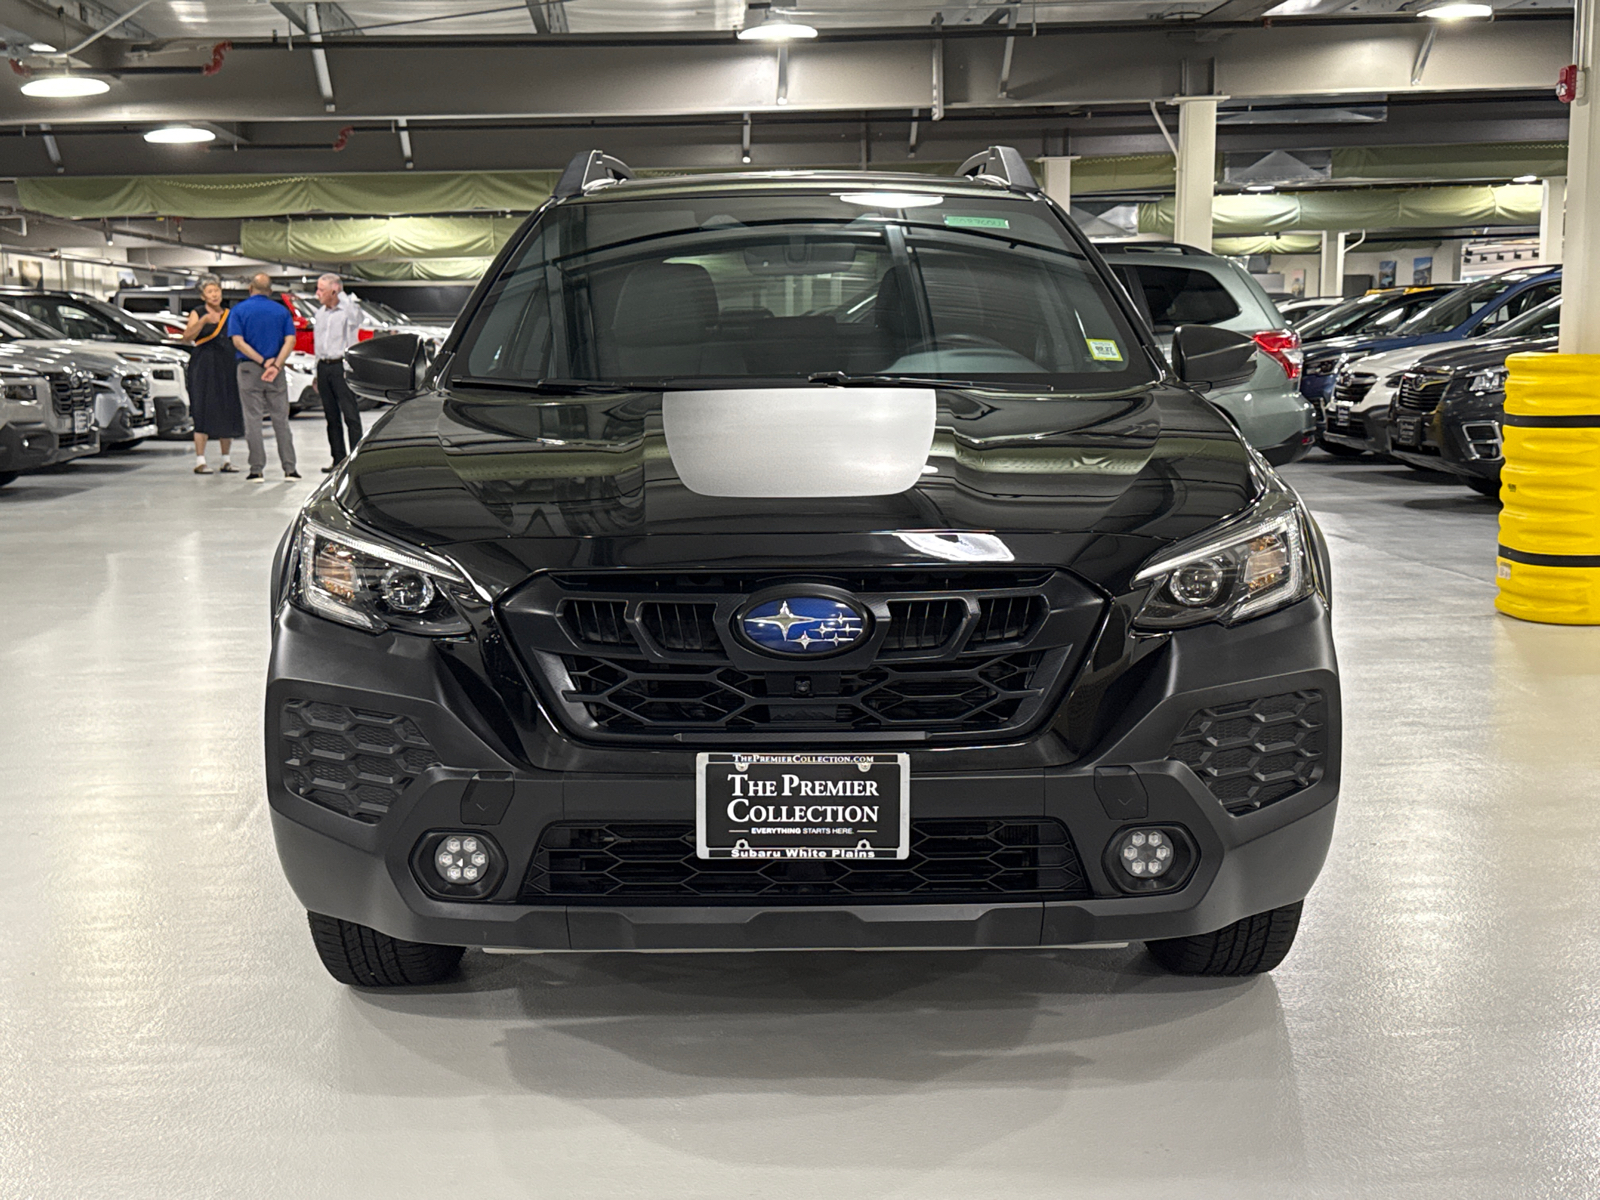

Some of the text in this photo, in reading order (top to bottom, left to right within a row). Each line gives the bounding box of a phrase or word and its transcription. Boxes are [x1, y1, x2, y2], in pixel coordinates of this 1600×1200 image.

[732, 754, 874, 763] THEPREMIERCOLLECTION.COM
[727, 773, 880, 797] THE PREMIER
[727, 798, 880, 823] COLLECTION
[750, 827, 802, 835] EVERYTHING
[802, 827, 831, 835] STARTS
[730, 849, 876, 858] Subaru White Plains
